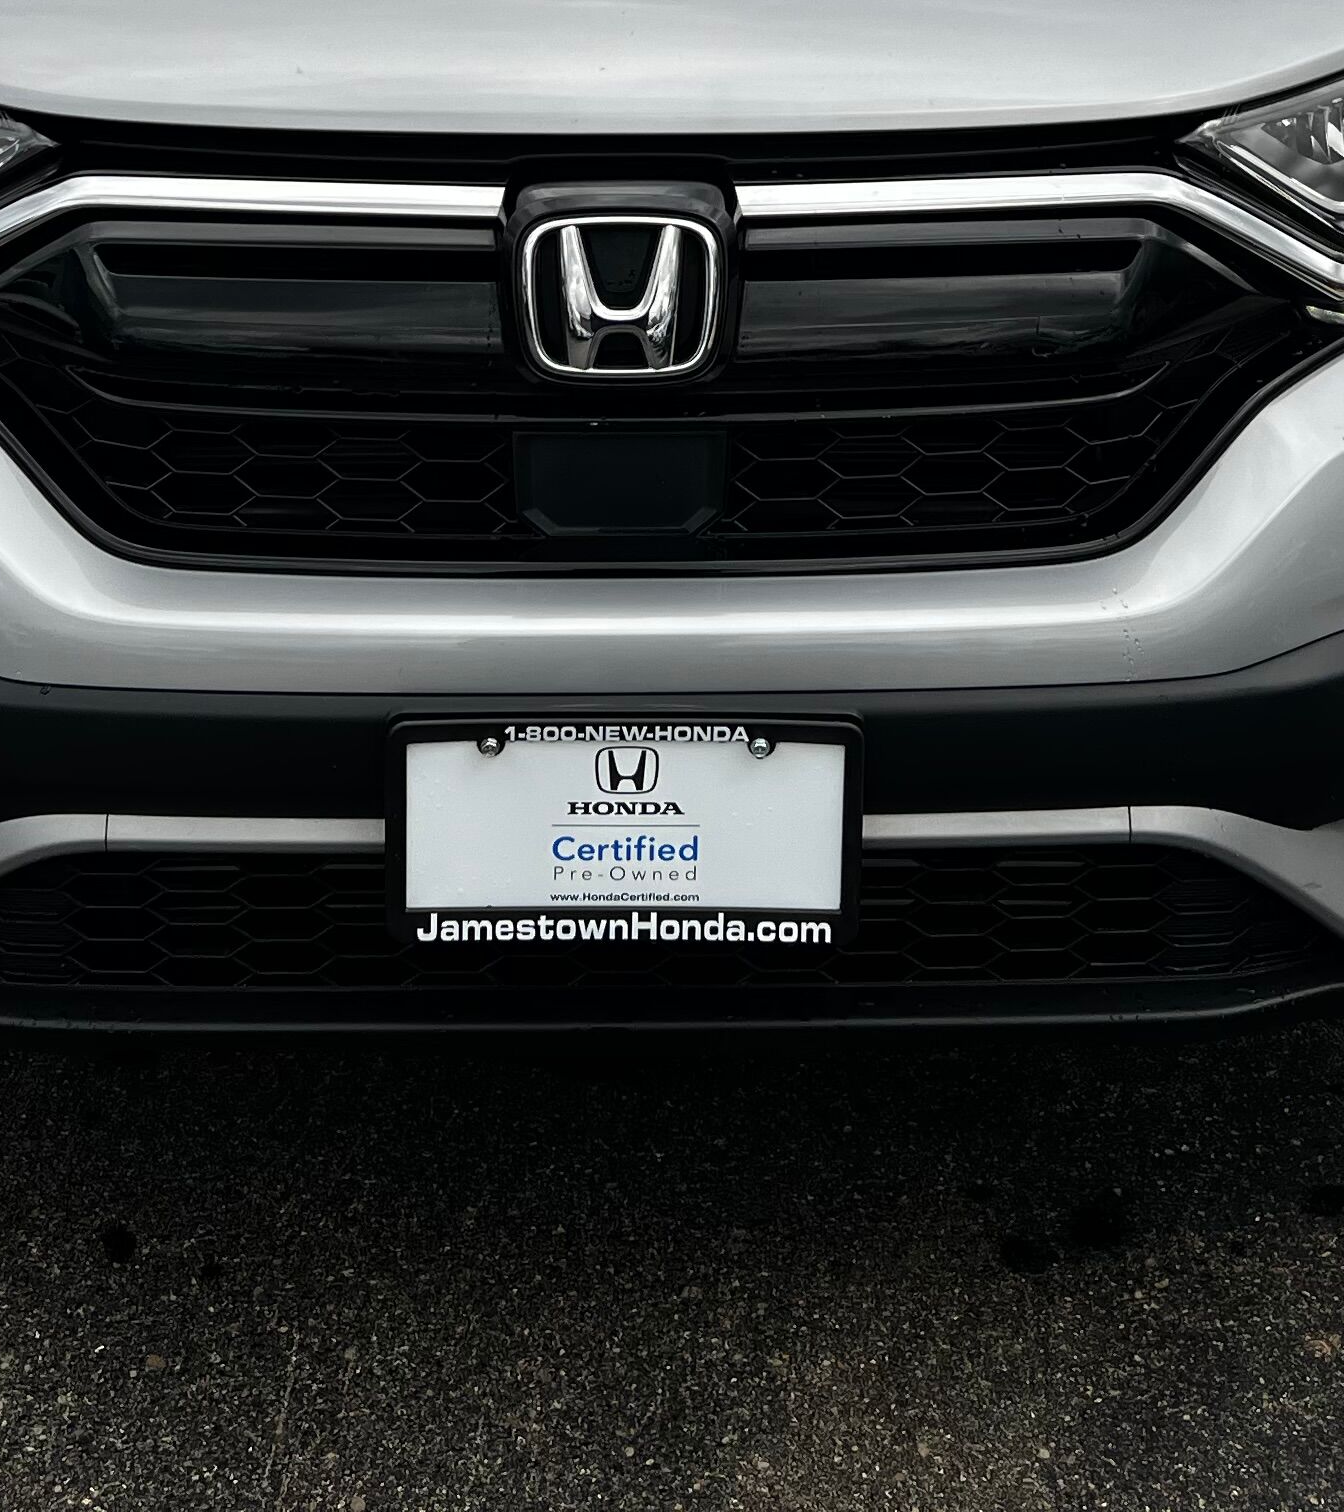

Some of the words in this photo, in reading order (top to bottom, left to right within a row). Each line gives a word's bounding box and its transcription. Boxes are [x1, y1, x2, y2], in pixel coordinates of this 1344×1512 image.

[504, 726, 750, 742] 1-800-NEW-HONDA
[567, 801, 685, 816] HONDA
[552, 835, 699, 862] Certified
[553, 866, 698, 882] Pre-Owned
[550, 891, 700, 903] www.HondaCertified.com
[416, 911, 832, 944] JamestownHonda.com
